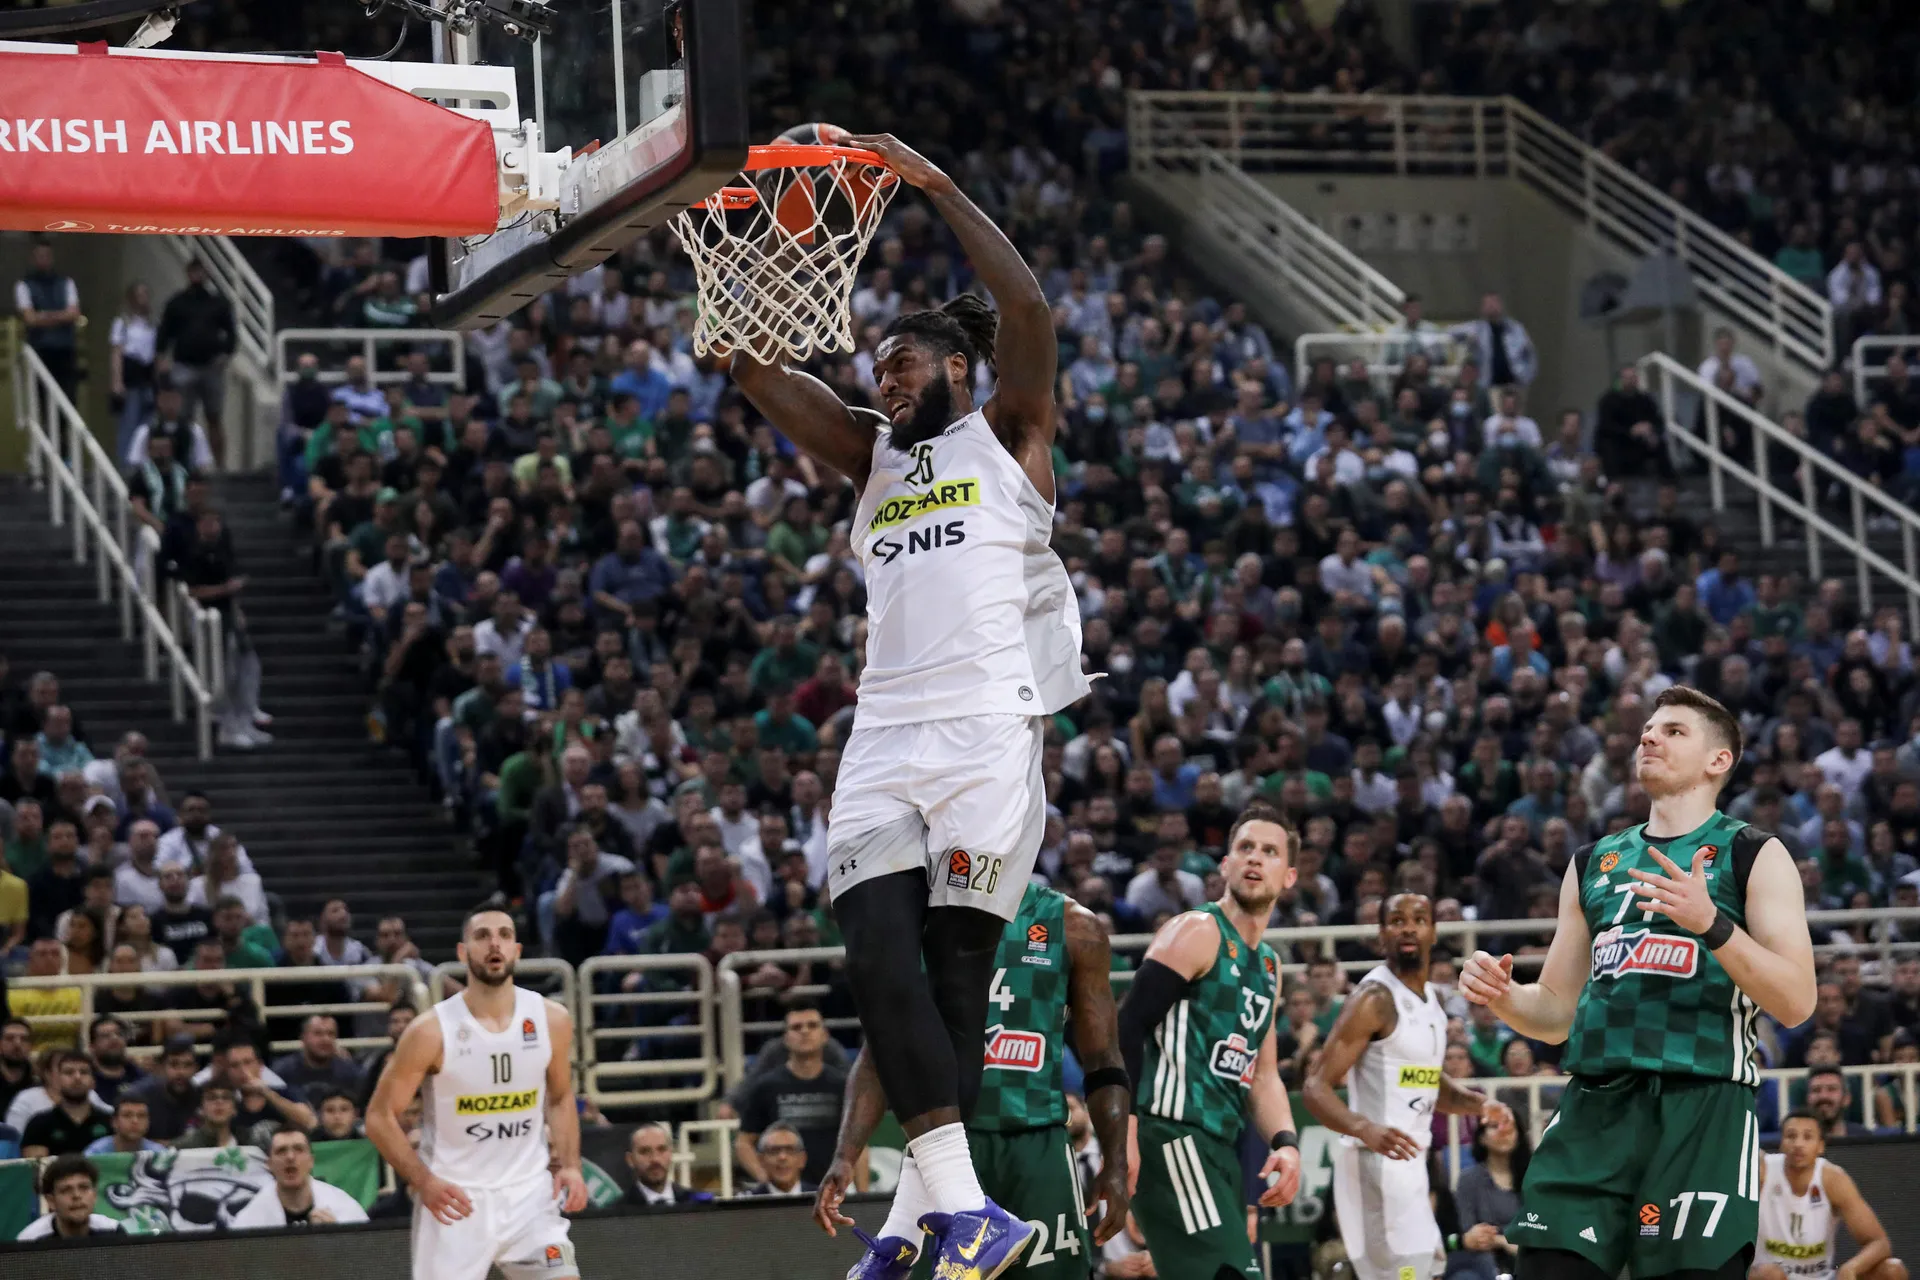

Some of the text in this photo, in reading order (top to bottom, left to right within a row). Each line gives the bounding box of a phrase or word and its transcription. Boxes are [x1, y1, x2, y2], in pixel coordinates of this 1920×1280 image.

[144, 120, 355, 155] AIRLINES
[107, 224, 346, 236] TURKISH AIRLINES
[909, 521, 965, 554] NIS
[970, 854, 1002, 894] 26
[1240, 986, 1271, 1033] 37
[490, 1052, 512, 1084] 10
[457, 1090, 538, 1112] MOZZART
[498, 1118, 532, 1139] NIS
[1026, 1213, 1081, 1268] 24
